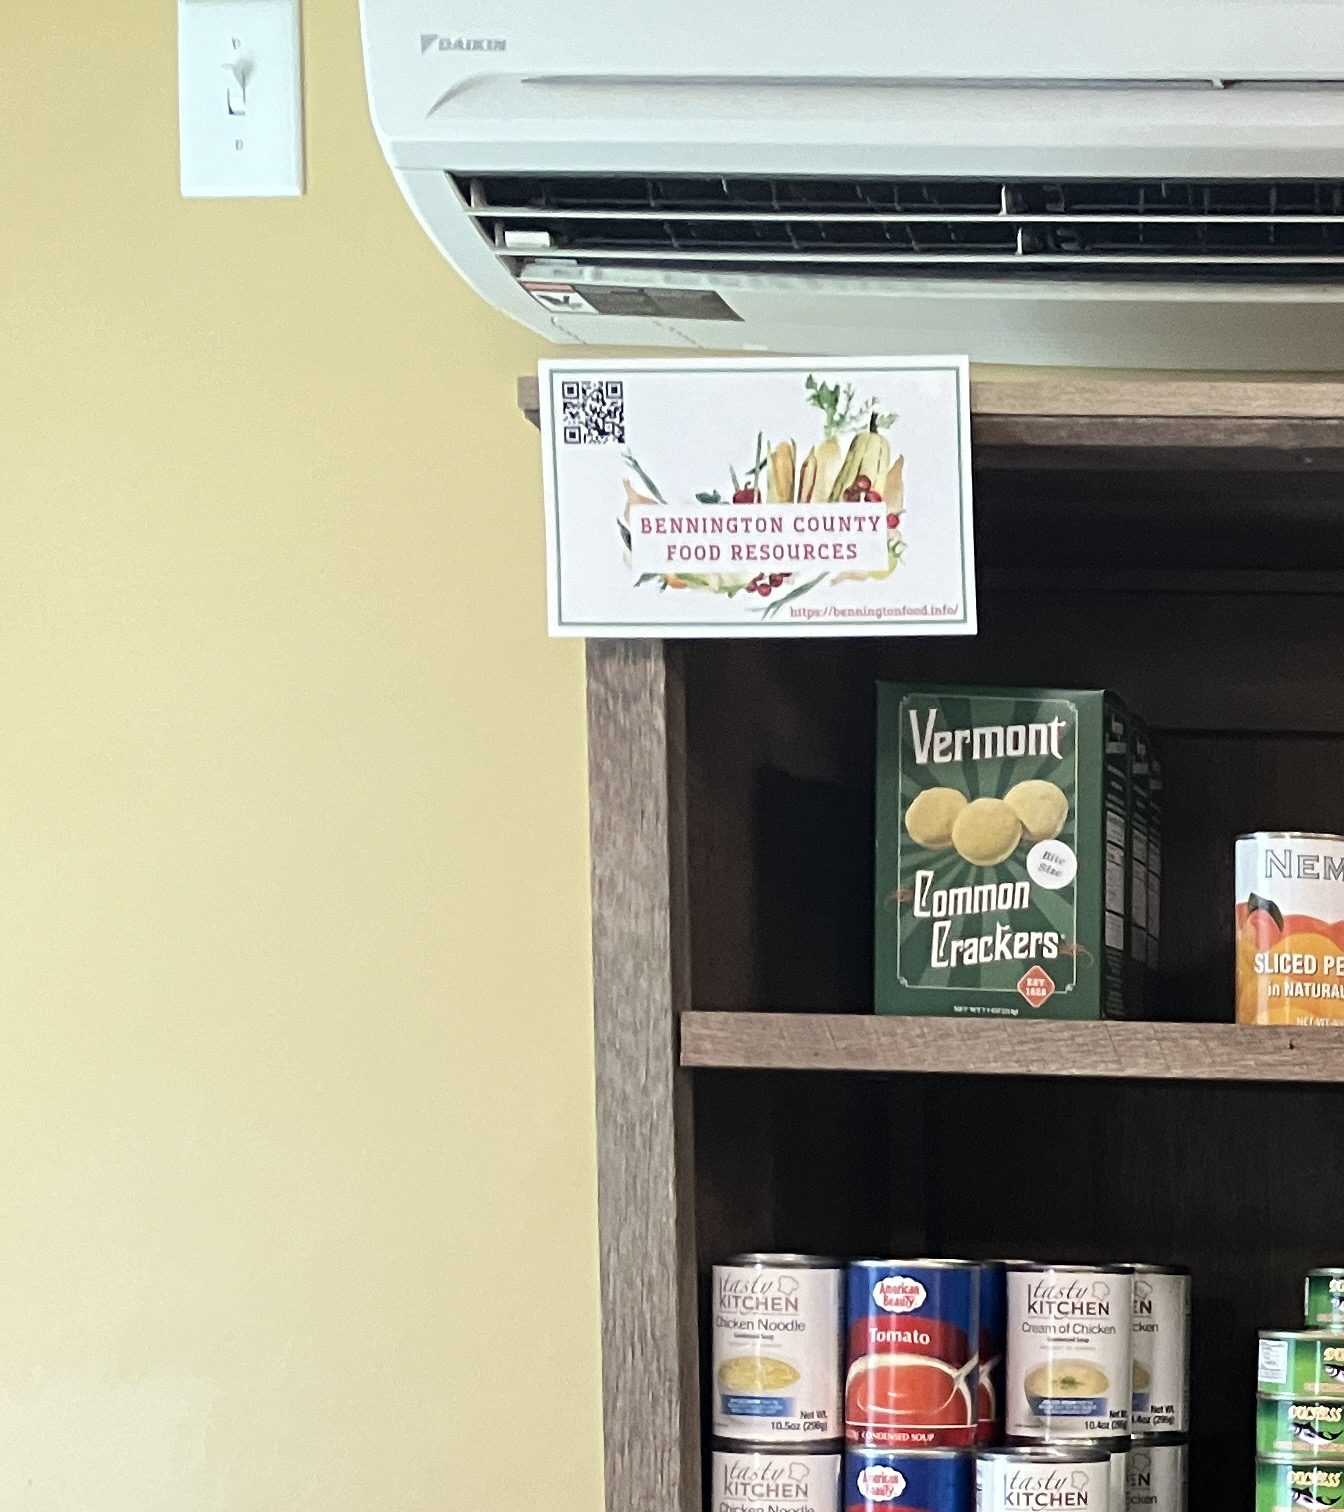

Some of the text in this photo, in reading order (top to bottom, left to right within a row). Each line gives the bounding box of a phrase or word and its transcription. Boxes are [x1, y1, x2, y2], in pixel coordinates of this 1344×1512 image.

[439, 39, 506, 51] DAIKIN
[640, 515, 881, 535] BENNINGTON COUNTY
[666, 543, 858, 561] FOOD RESOURCES
[909, 708, 1067, 765] Vermont
[913, 870, 1031, 918] Common
[930, 920, 1060, 968] Crackers
[1254, 953, 1317, 974] SLICED
[1268, 984, 1280, 997] in
[719, 1294, 799, 1313] KITCHEN
[1027, 1300, 1110, 1316] KITCHEN
[716, 1315, 806, 1332] Chicken Noodle
[1022, 1321, 1116, 1335] Cream of Chicken
[870, 1328, 931, 1346] Tomato
[723, 1480, 808, 1498] KITCHEN
[1004, 1491, 1088, 1506] KITCHEN
